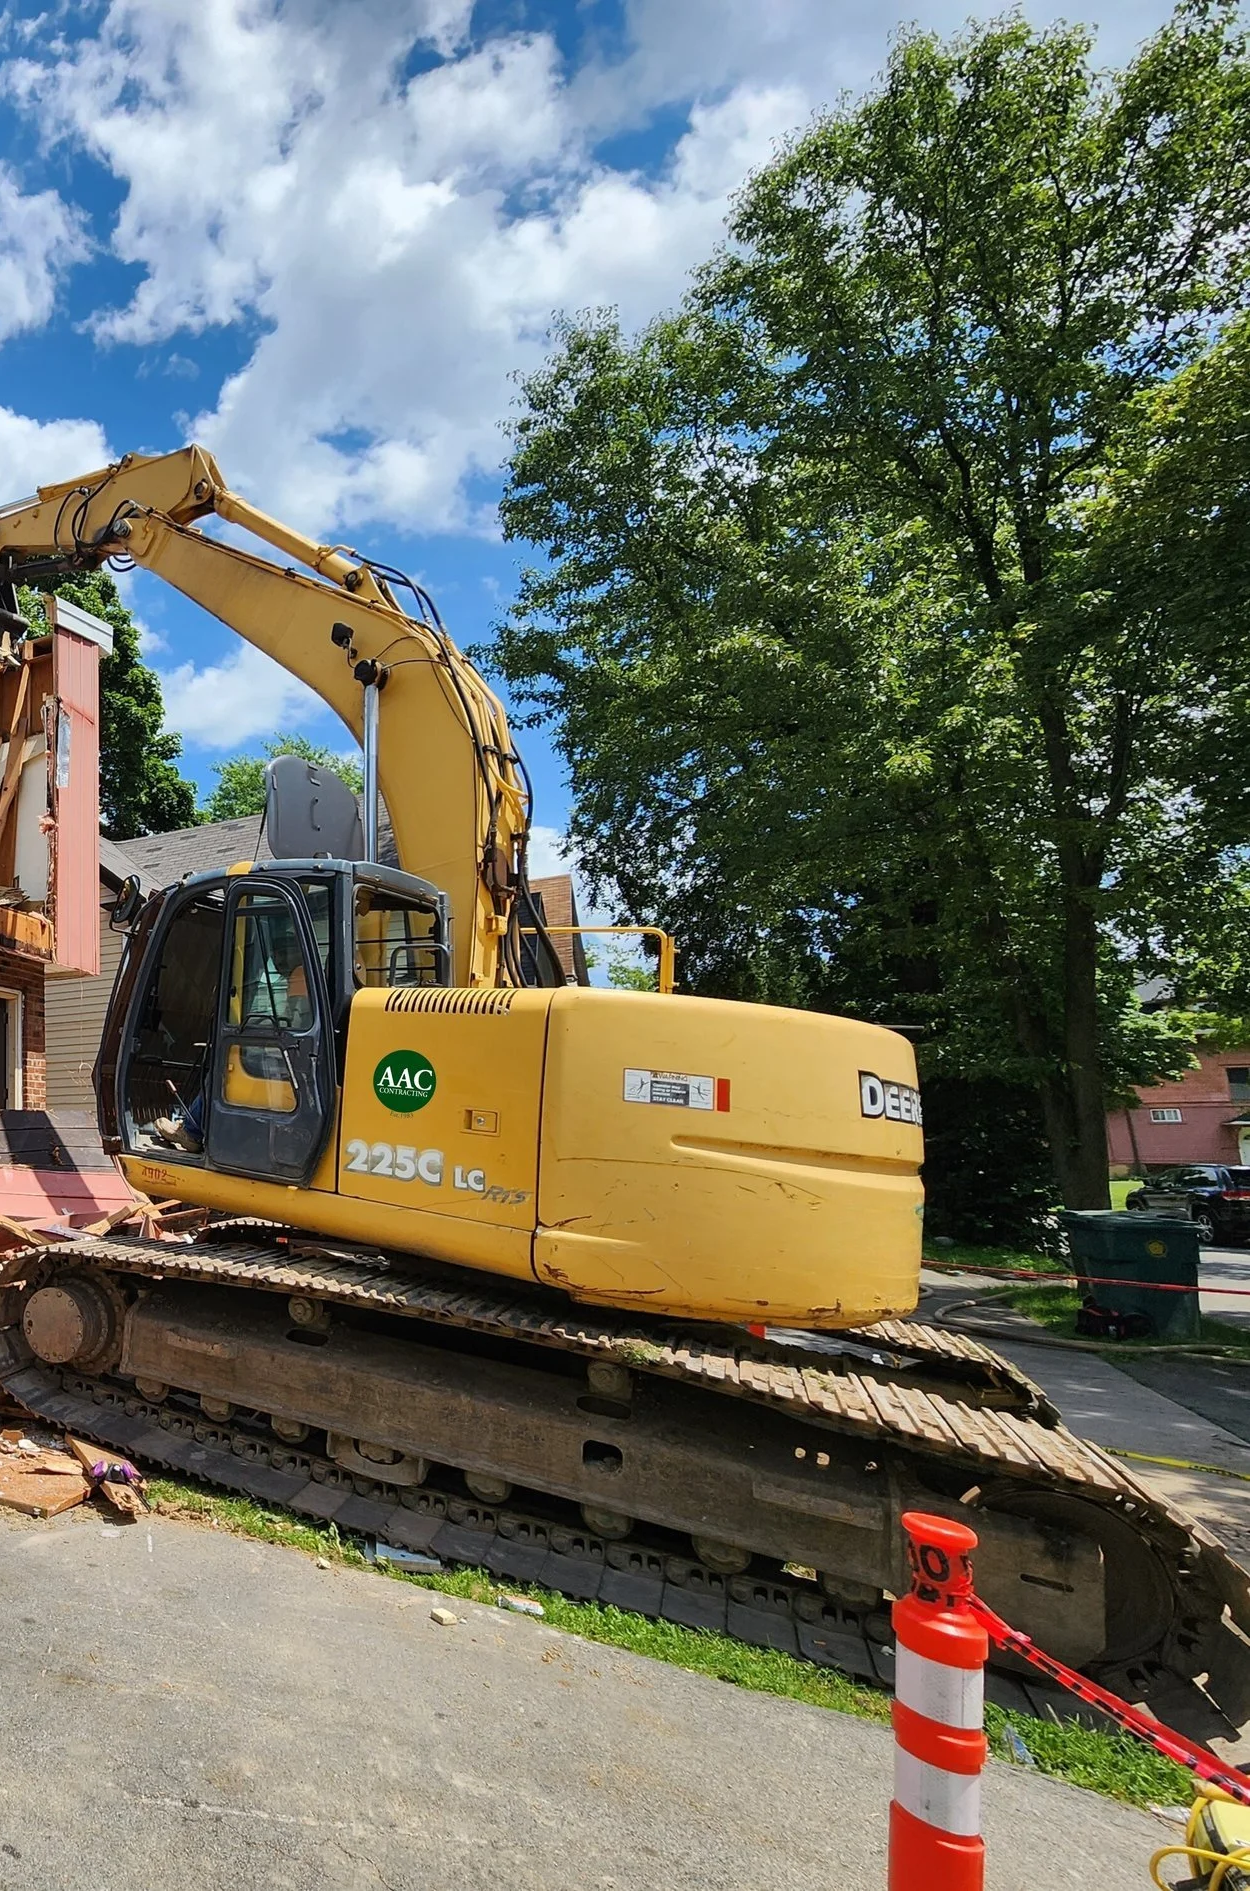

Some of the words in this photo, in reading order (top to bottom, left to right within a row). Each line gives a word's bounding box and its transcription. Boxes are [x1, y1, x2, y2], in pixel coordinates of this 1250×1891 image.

[377, 1065, 433, 1091] AAC
[658, 1072, 688, 1082] WARNING
[379, 1087, 428, 1098] CONTRACTING
[345, 1139, 443, 1186] 225C
[453, 1165, 485, 1192] LC
